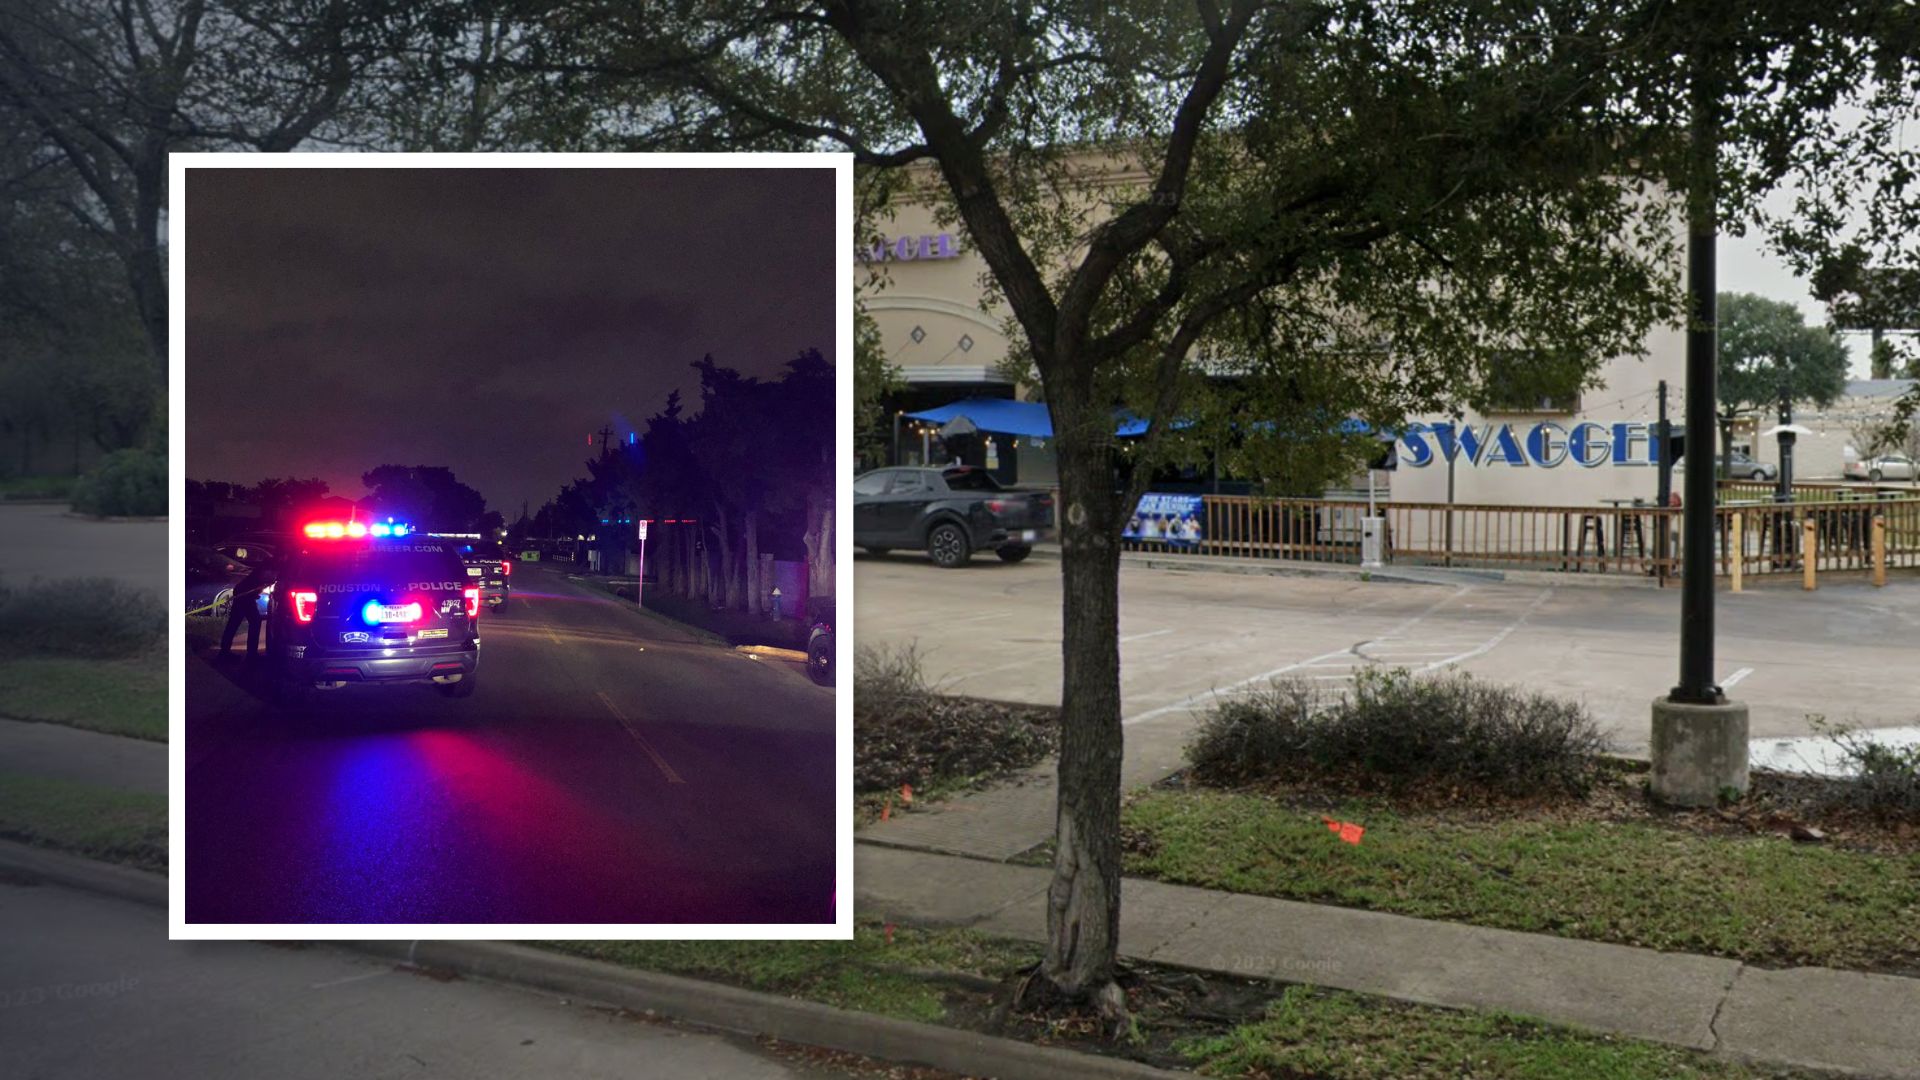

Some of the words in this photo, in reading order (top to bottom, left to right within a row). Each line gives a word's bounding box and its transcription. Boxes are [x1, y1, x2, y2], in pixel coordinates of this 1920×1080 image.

[1398, 421, 1659, 468] SWAGGE
[319, 584, 380, 593] HOUSTON
[408, 582, 462, 591] POLICE
